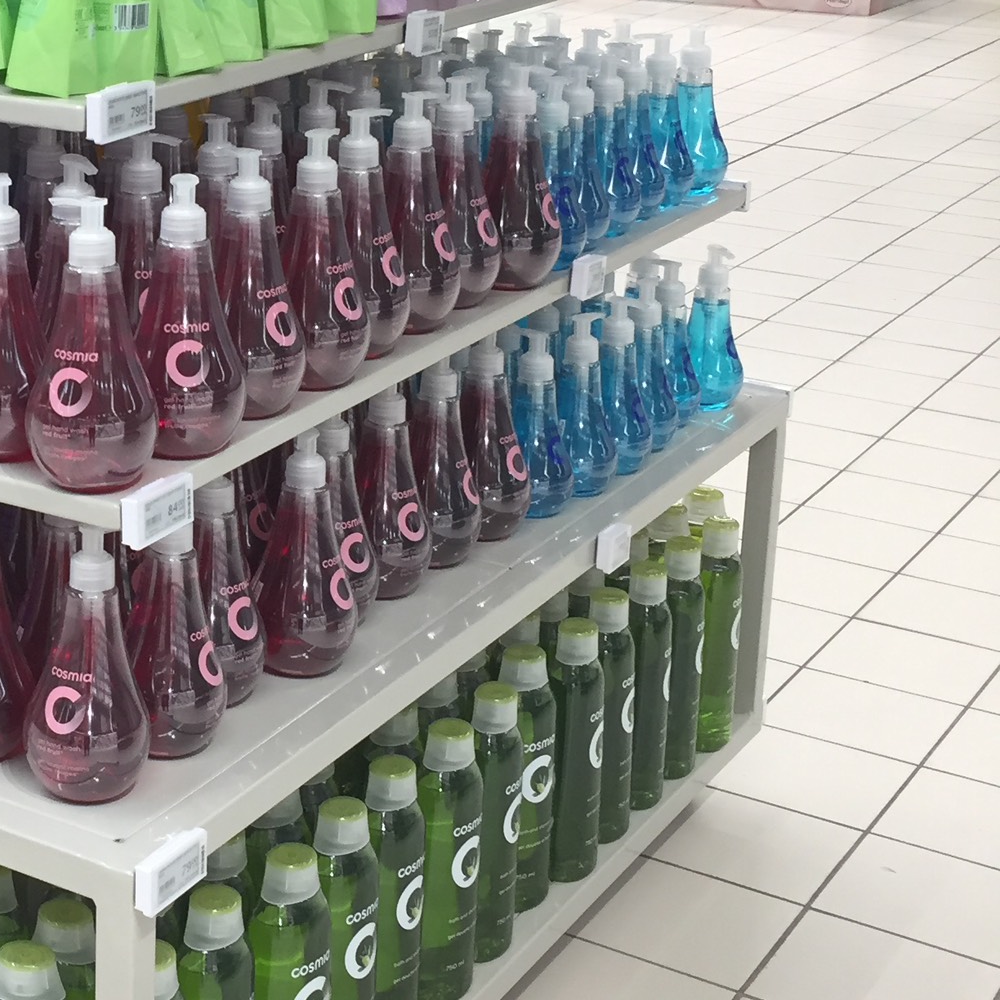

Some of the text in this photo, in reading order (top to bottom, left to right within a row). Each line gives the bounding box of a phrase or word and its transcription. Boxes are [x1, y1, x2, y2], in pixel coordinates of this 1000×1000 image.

[257, 281, 288, 300] cosmi
[163, 321, 210, 334] cosmia
[54, 348, 99, 363] cosmia
[51, 664, 94, 683] cosmia
[291, 949, 331, 979] cosmi
